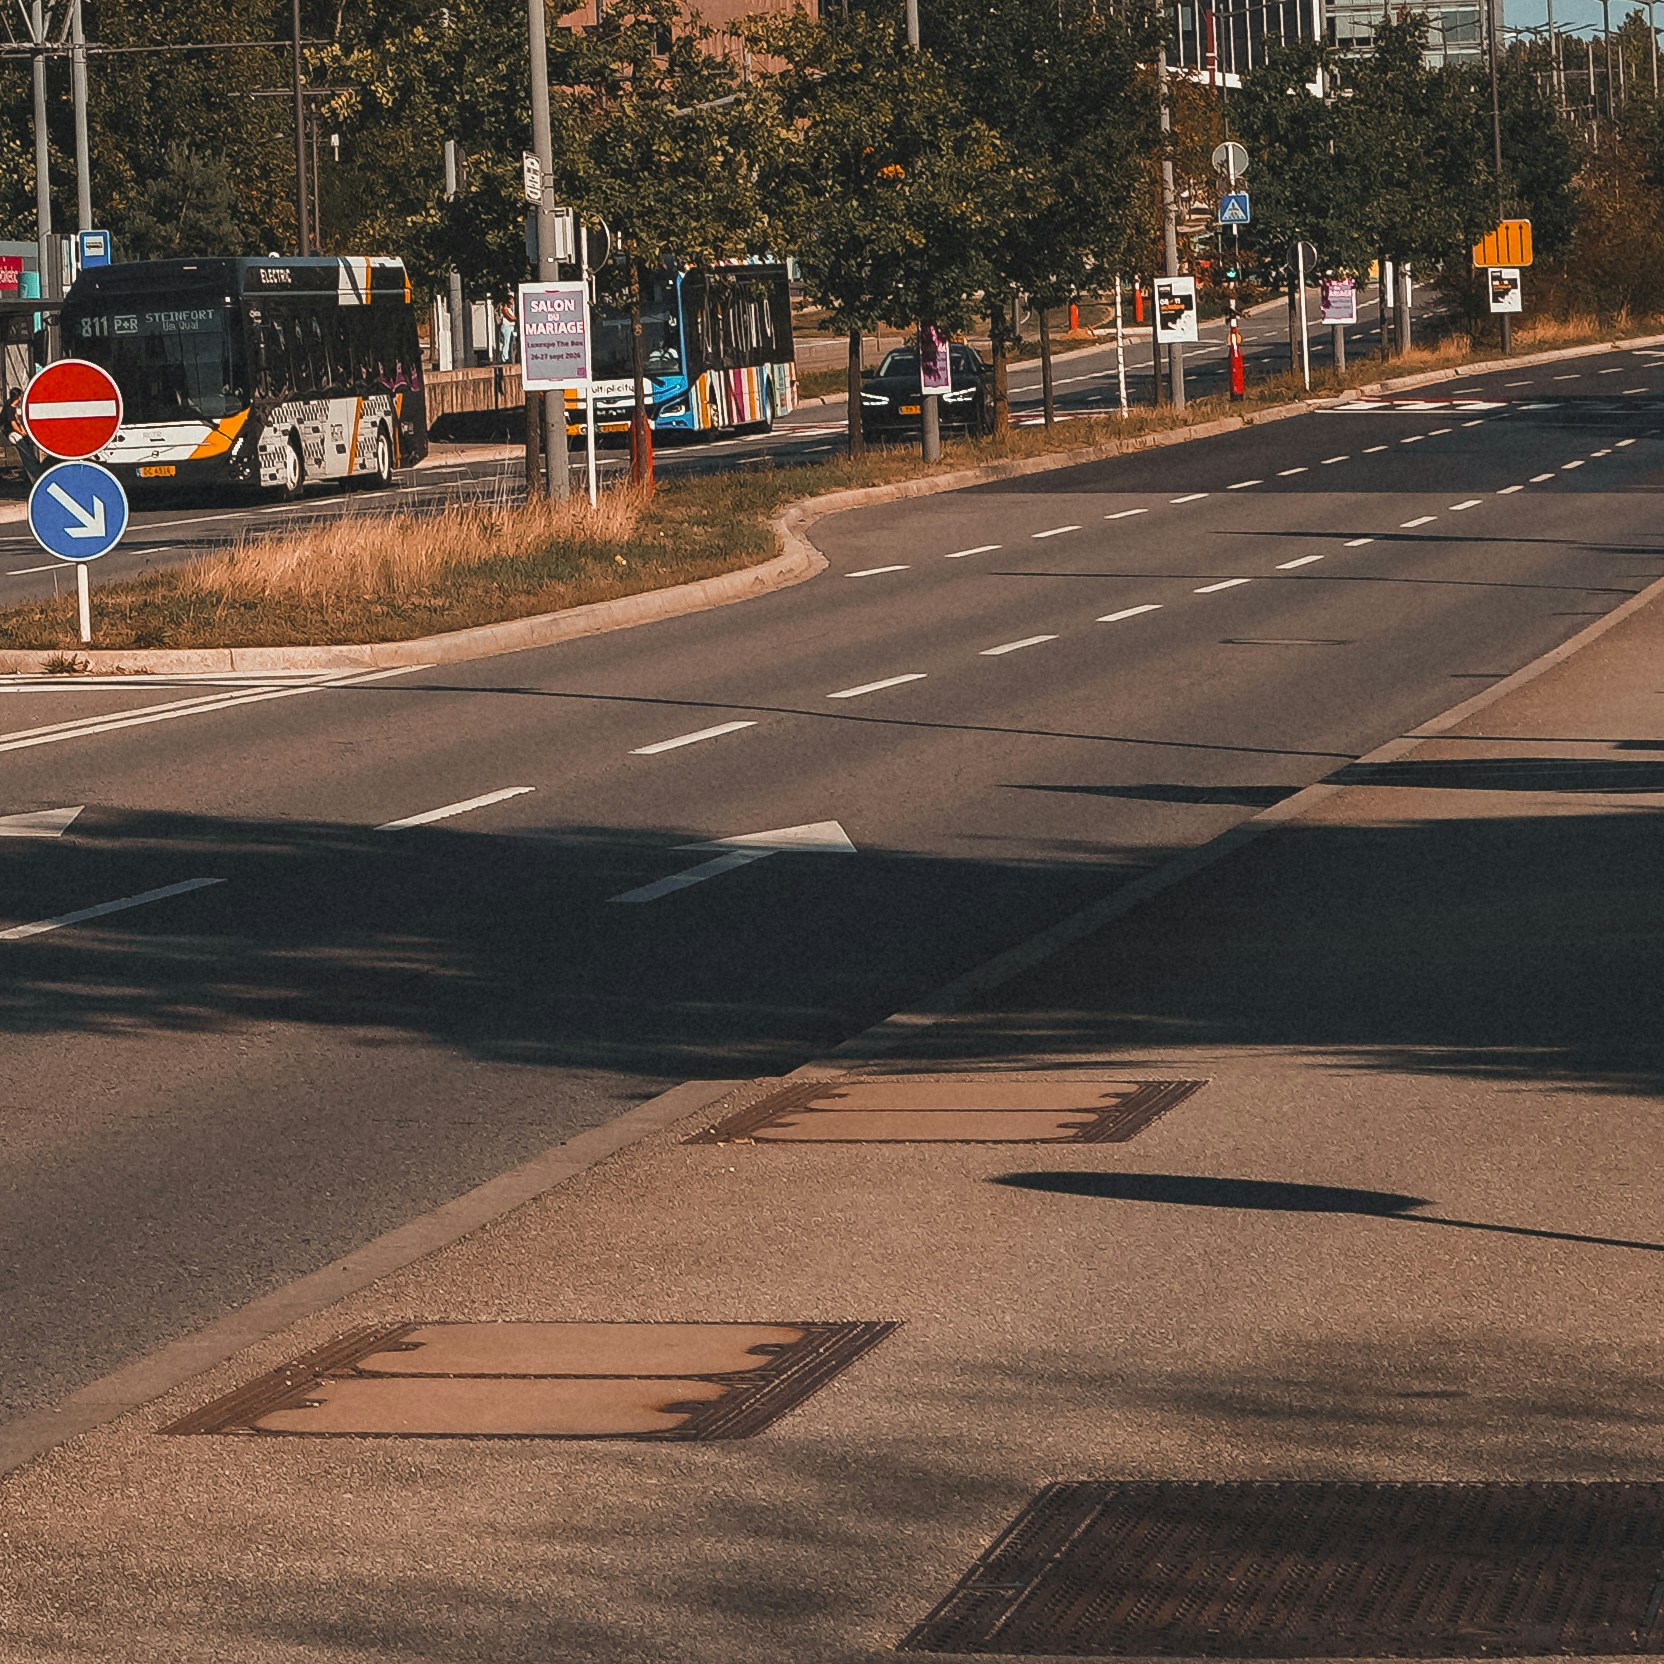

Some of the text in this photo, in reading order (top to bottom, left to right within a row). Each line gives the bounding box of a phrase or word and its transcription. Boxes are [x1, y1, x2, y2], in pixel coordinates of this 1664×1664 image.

[260, 268, 292, 284] ELECTRIC
[530, 299, 575, 313] SALON
[81, 316, 108, 337] 811
[145, 309, 215, 323] STEINFORT
[547, 313, 560, 321] DU
[525, 321, 584, 335] MARIAGE
[591, 383, 635, 395] ultiplicity
